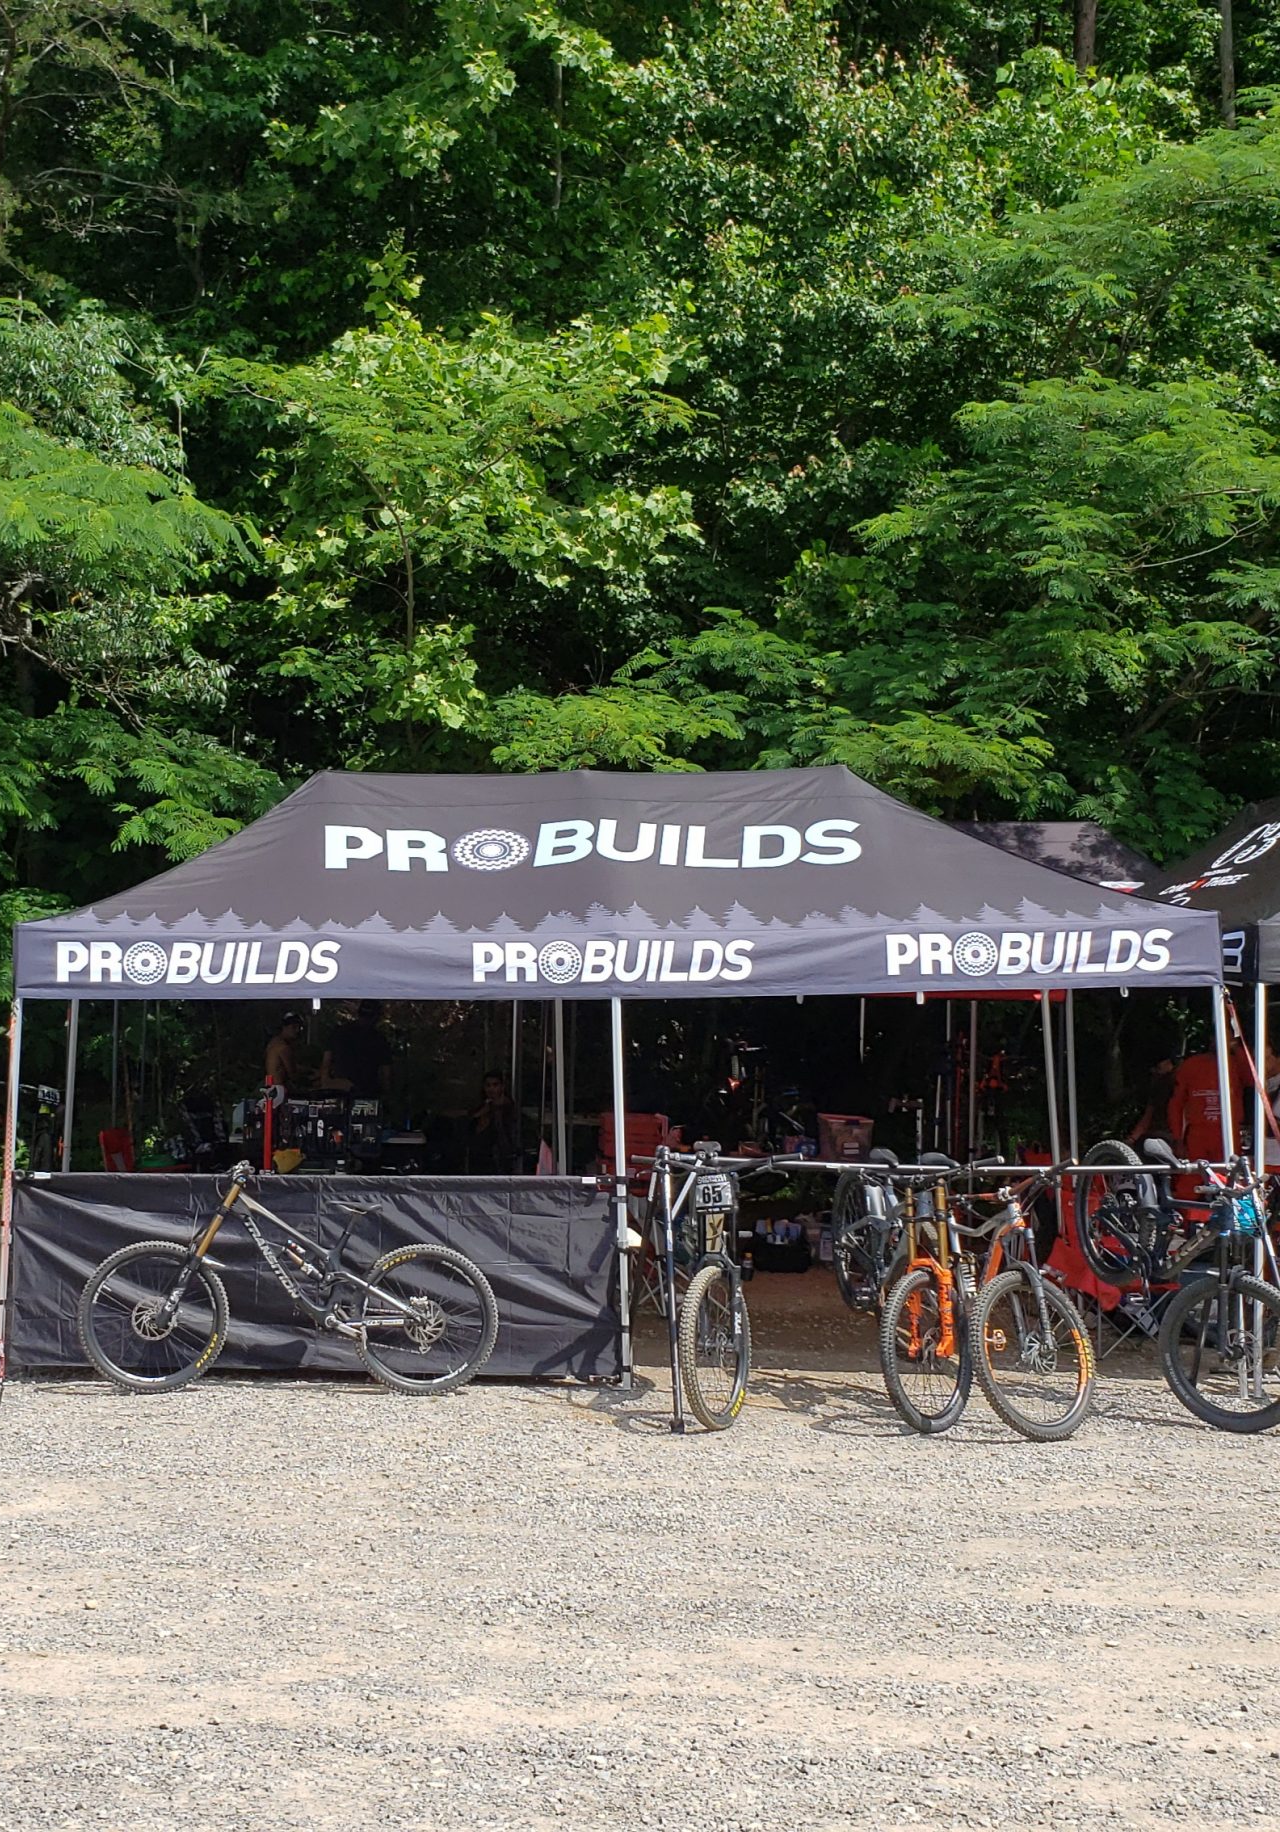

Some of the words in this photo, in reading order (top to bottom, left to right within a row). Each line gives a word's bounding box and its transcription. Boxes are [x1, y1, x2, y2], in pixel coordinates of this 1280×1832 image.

[323, 817, 863, 873] PROBUILDS
[56, 940, 341, 985] PROBUILDS
[472, 939, 756, 984] PROBUILDS
[885, 928, 1174, 977] PROBUILDS
[702, 1184, 723, 1205] 65
